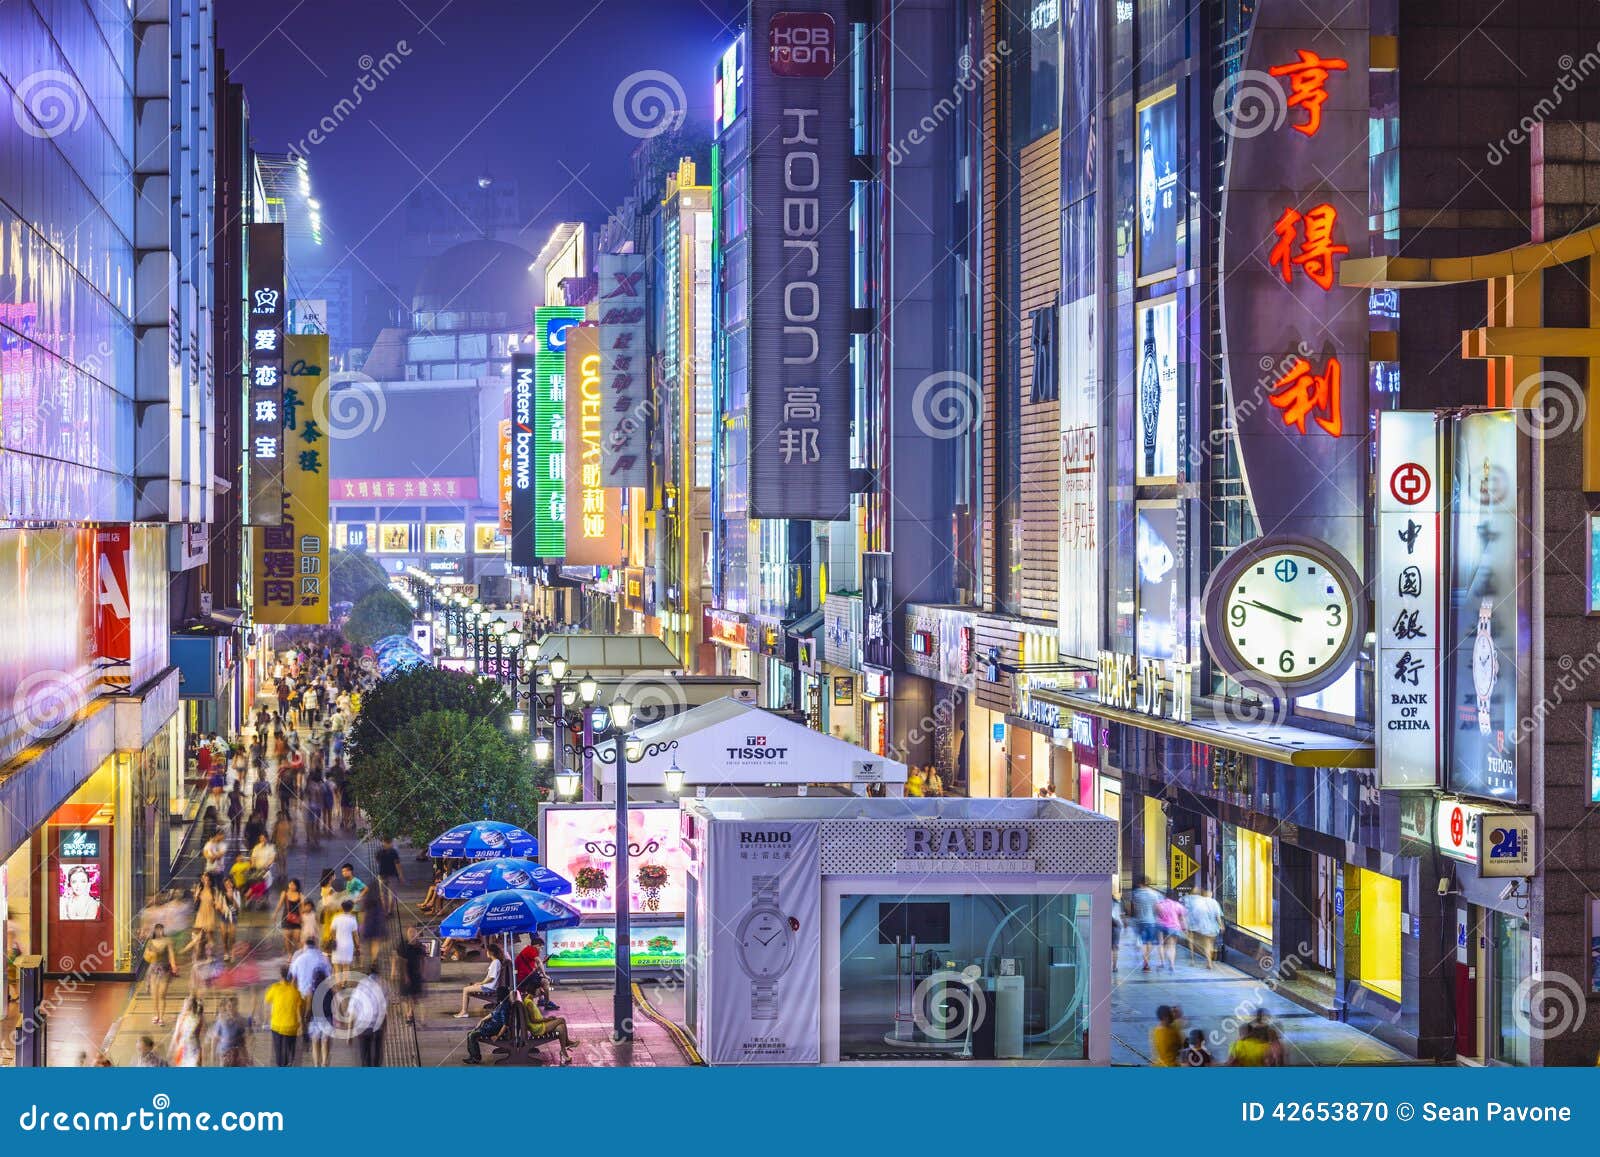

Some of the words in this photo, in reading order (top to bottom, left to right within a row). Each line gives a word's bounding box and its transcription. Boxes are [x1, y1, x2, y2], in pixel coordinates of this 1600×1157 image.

[1268, 49, 1350, 438] 亨得利
[254, 329, 277, 458] 爱恋珠宝
[517, 368, 533, 490] Meters/bonwe
[779, 386, 821, 465] 高邦
[345, 480, 396, 497] 文明城市
[1231, 605, 1247, 627] 9
[1326, 604, 1342, 627] 3
[1279, 650, 1295, 673] 6
[1391, 693, 1428, 705] BANK
[1400, 707, 1418, 718] OF
[1387, 720, 1431, 730] CHINA
[726, 747, 788, 759] TISSOT
[1487, 756, 1514, 776] TUDOR
[740, 831, 792, 843] RADO
[904, 827, 1029, 858] RADO
[1178, 835, 1190, 846] 3F
[905, 861, 1030, 872] SWITZERLAND
